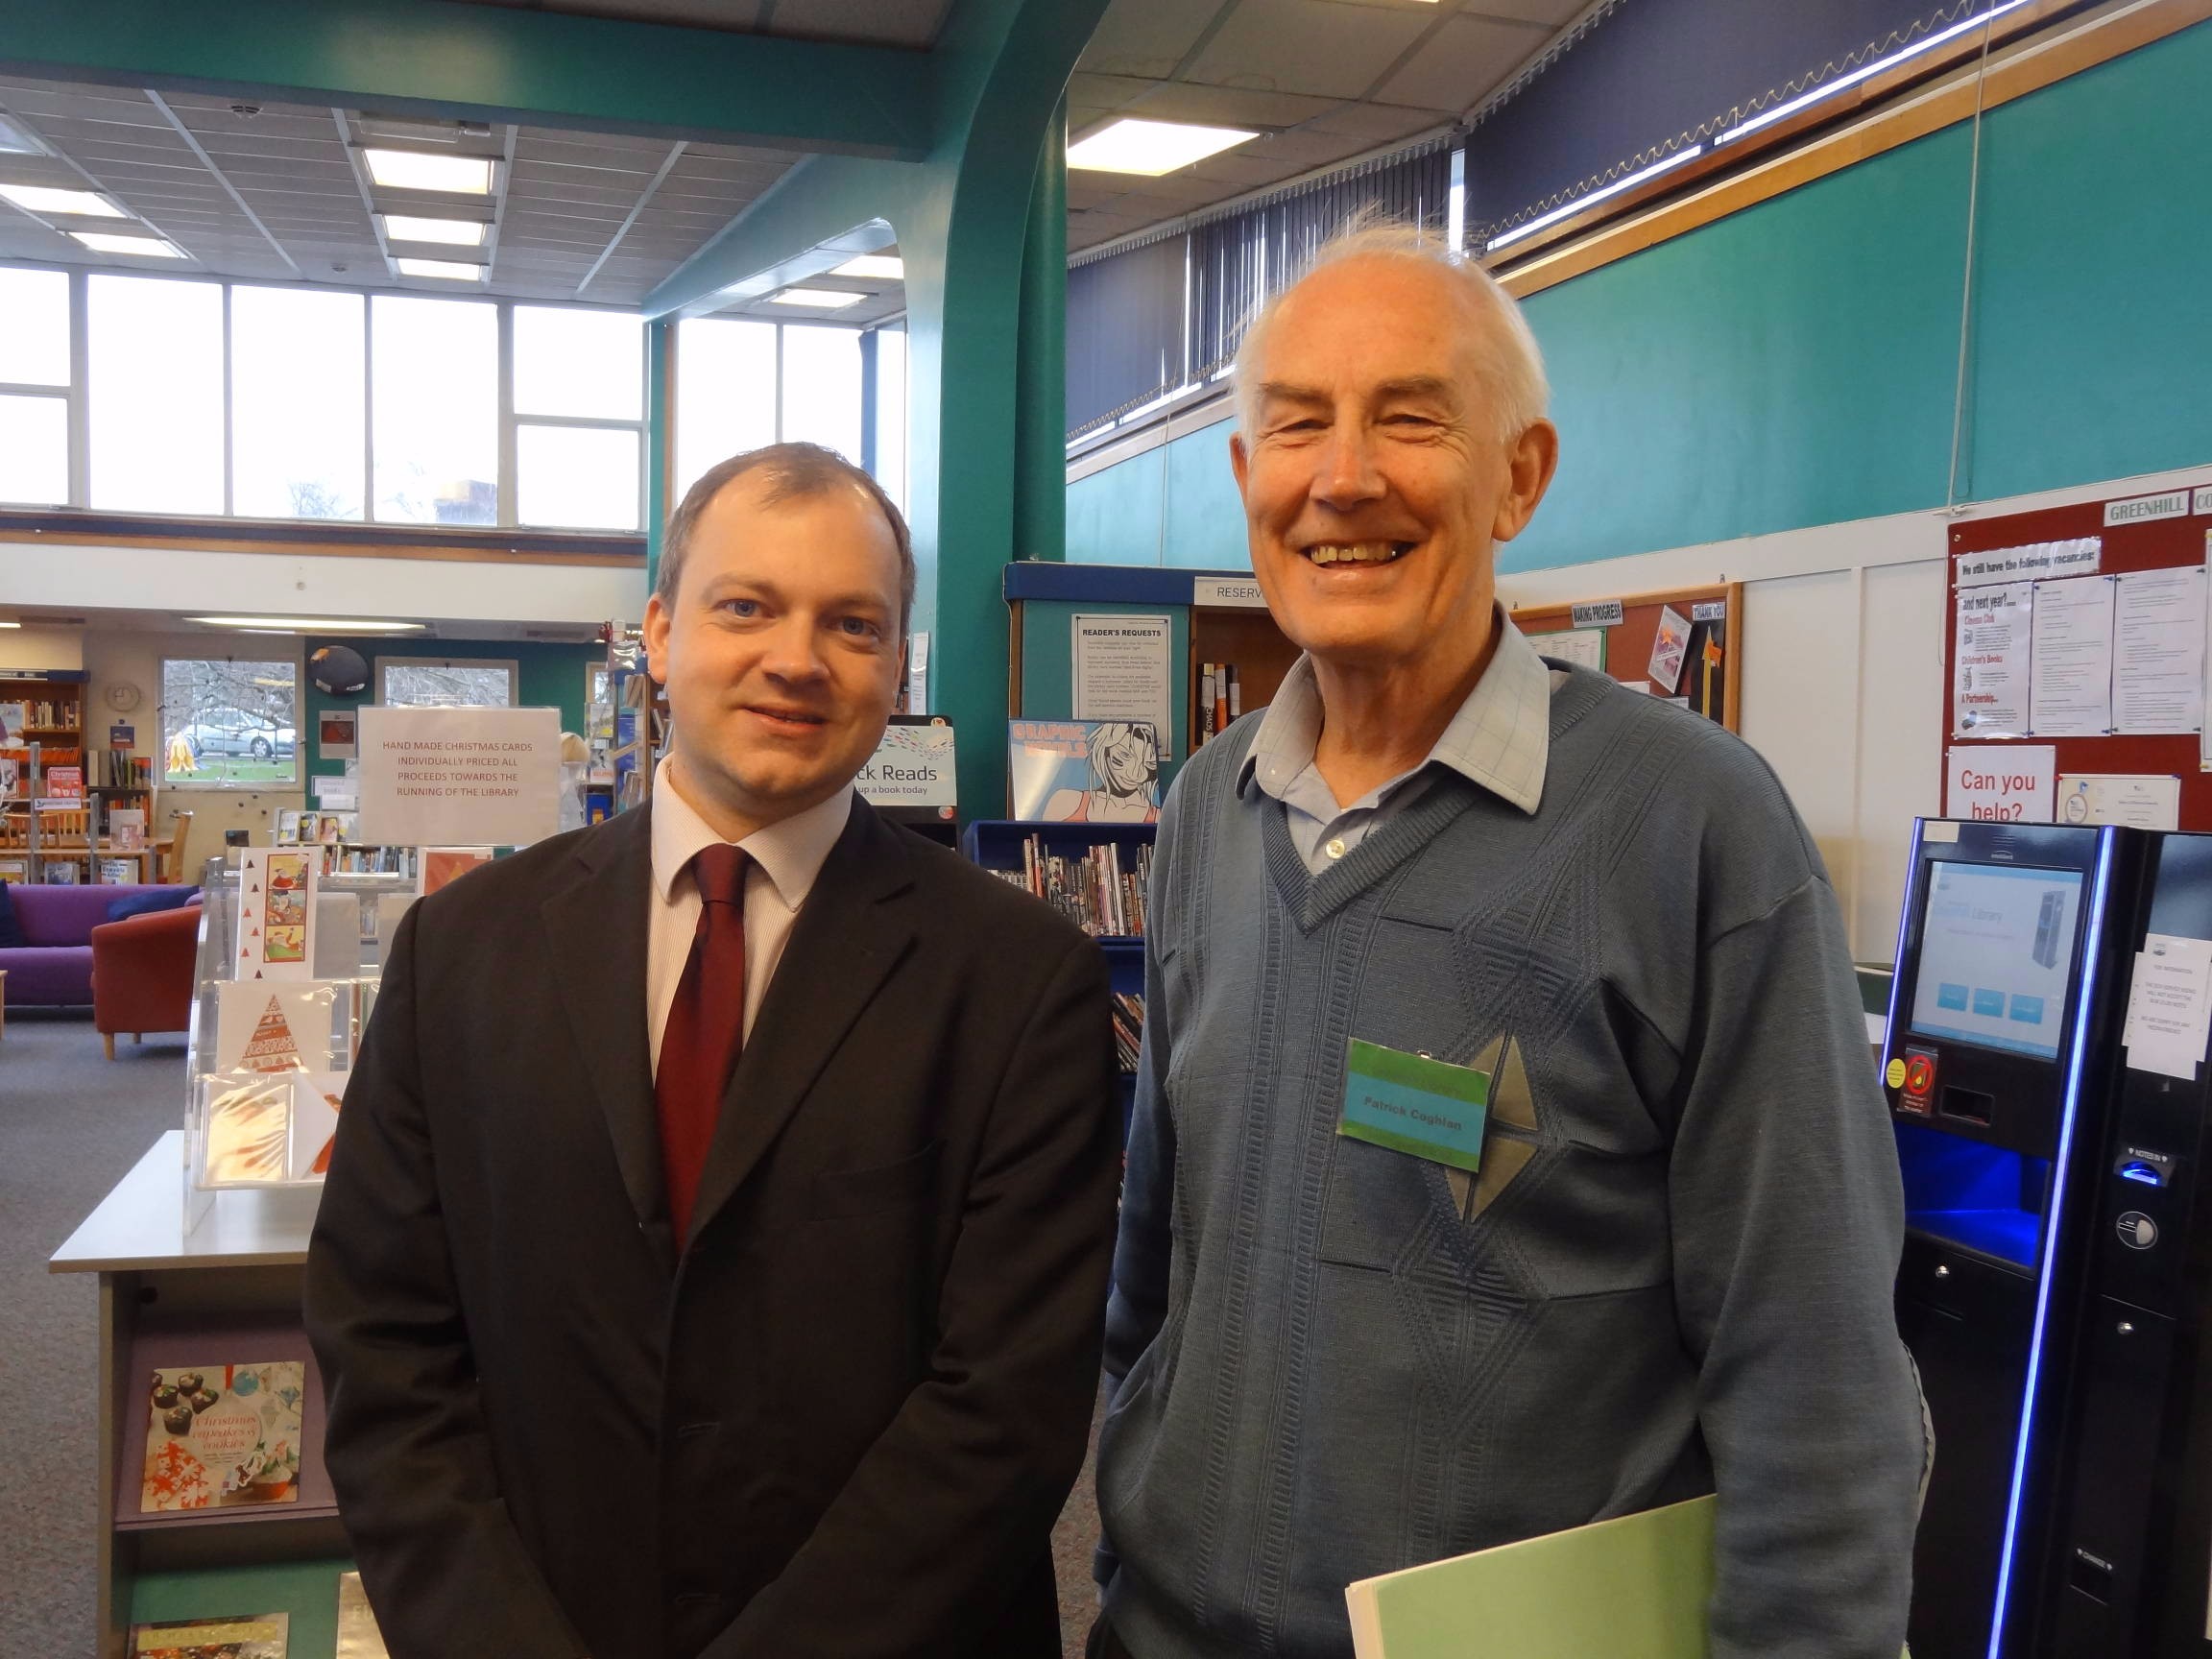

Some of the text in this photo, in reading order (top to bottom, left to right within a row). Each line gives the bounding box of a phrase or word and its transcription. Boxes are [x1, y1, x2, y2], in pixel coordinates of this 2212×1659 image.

[2110, 496, 2184, 520] GREENHILL
[1985, 562, 2004, 573] have
[2005, 559, 2018, 570] the
[1962, 596, 1975, 610] and
[1975, 595, 1989, 610] next
[1573, 603, 1622, 622] MAKING PROGRESS
[383, 741, 533, 752] HAND MADE CHRISTMAS CARDS
[397, 757, 518, 766] INDIVIDUALLY PRICED ALL
[397, 772, 518, 781] PROCEEDS TOWARDS THE
[882, 764, 937, 781] Reads
[1960, 769, 2035, 796] Can you
[397, 787, 519, 797] RUNNING OF THE LIBRARY
[858, 786, 870, 795] up
[878, 785, 901, 794] book
[902, 785, 928, 795] today
[1971, 802, 2023, 822] help?
[1363, 1095, 1463, 1131] Patrick Coghlan
[195, 1414, 256, 1427] Christmas
